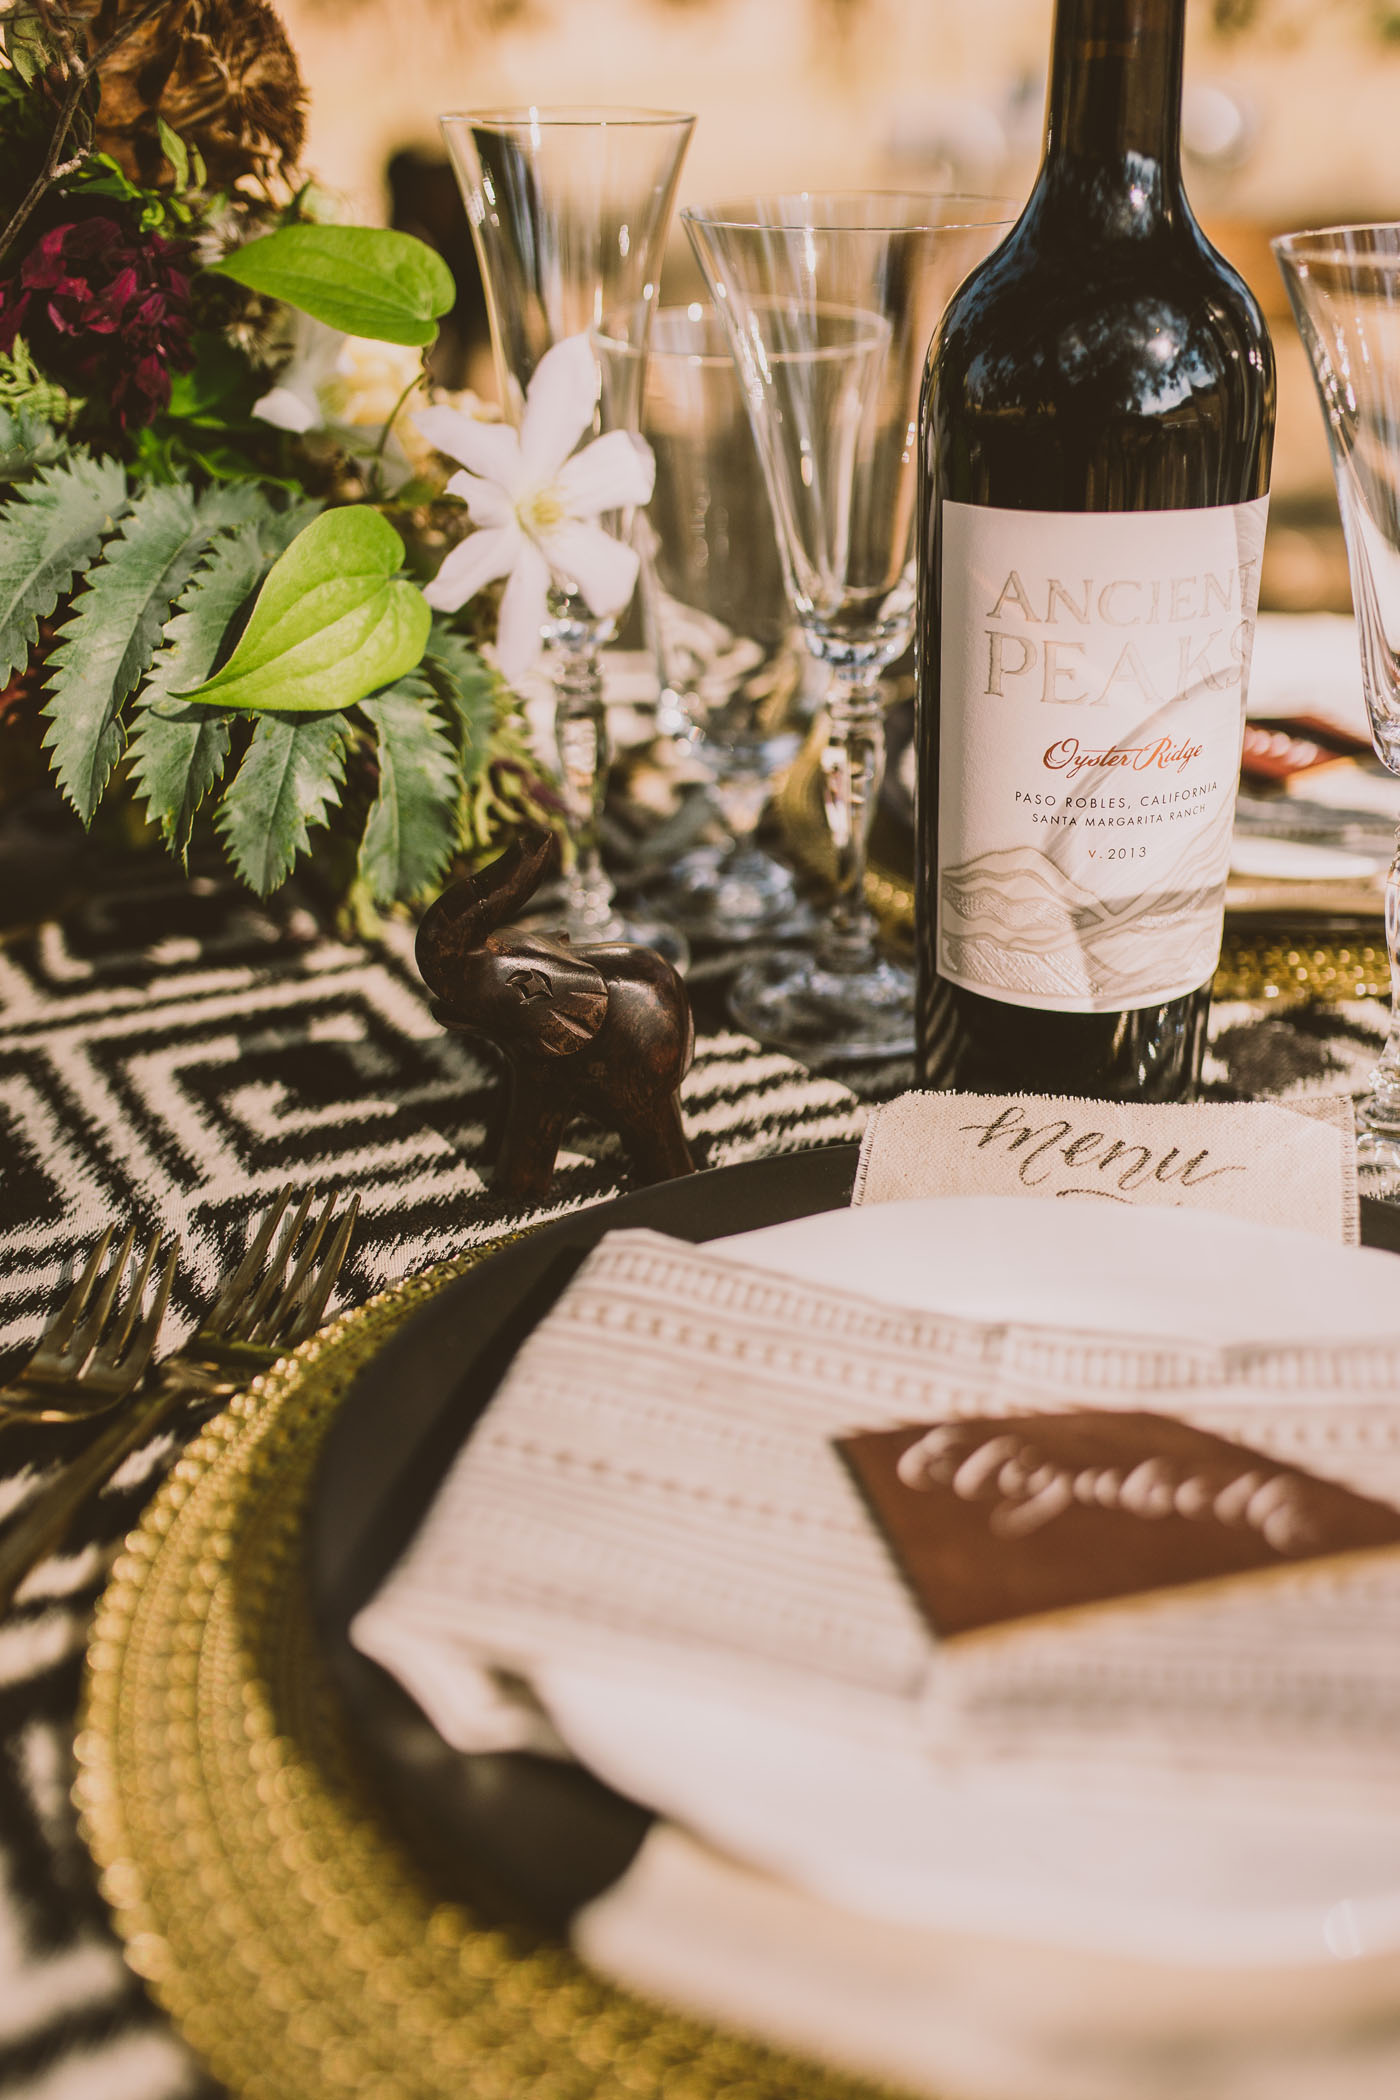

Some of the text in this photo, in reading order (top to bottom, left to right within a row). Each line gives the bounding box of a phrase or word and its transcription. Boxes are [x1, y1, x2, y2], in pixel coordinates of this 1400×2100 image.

[986, 558, 1257, 625] ANCIENT
[983, 618, 1250, 705] PEAKS
[1043, 738, 1133, 778] Oyster
[1132, 734, 1203, 774] Ridge
[1015, 781, 1218, 810] PASO ROBLES, CALIFORNIA
[1032, 804, 1206, 827] SANTA MARGARITA RANCH
